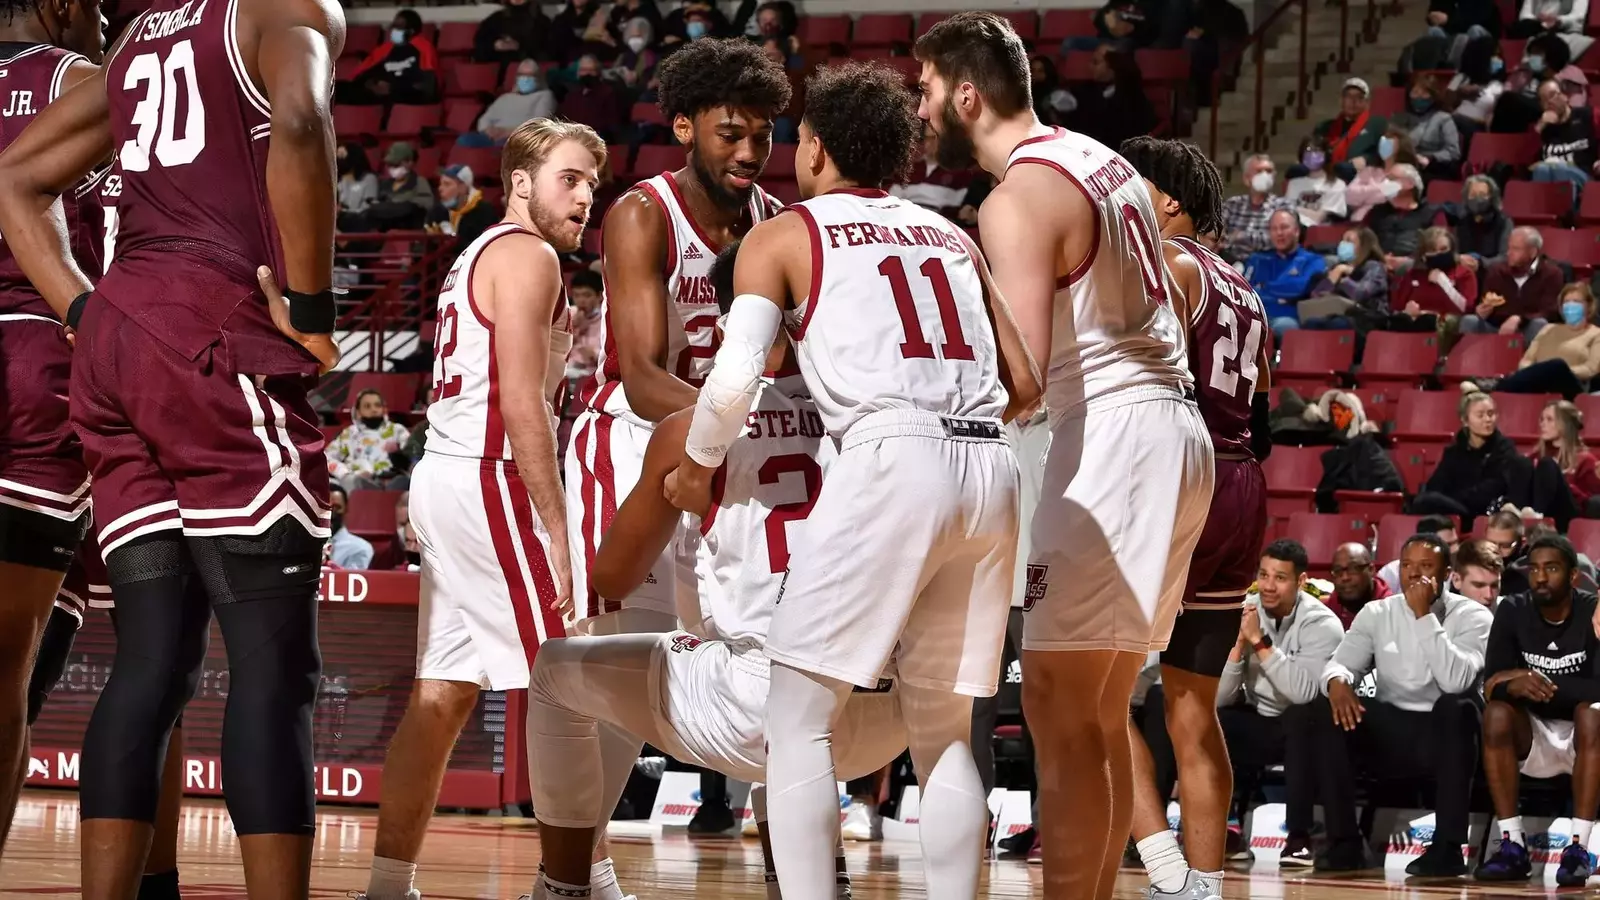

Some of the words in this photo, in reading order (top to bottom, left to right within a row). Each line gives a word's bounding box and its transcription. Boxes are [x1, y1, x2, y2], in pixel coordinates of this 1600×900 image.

[2, 90, 37, 117] JR.
[120, 39, 205, 171] 30
[824, 222, 966, 254] FERNANDES
[877, 255, 976, 361] 11
[1209, 301, 1262, 407] 24
[745, 409, 830, 440] STEAD
[758, 452, 823, 575] 2
